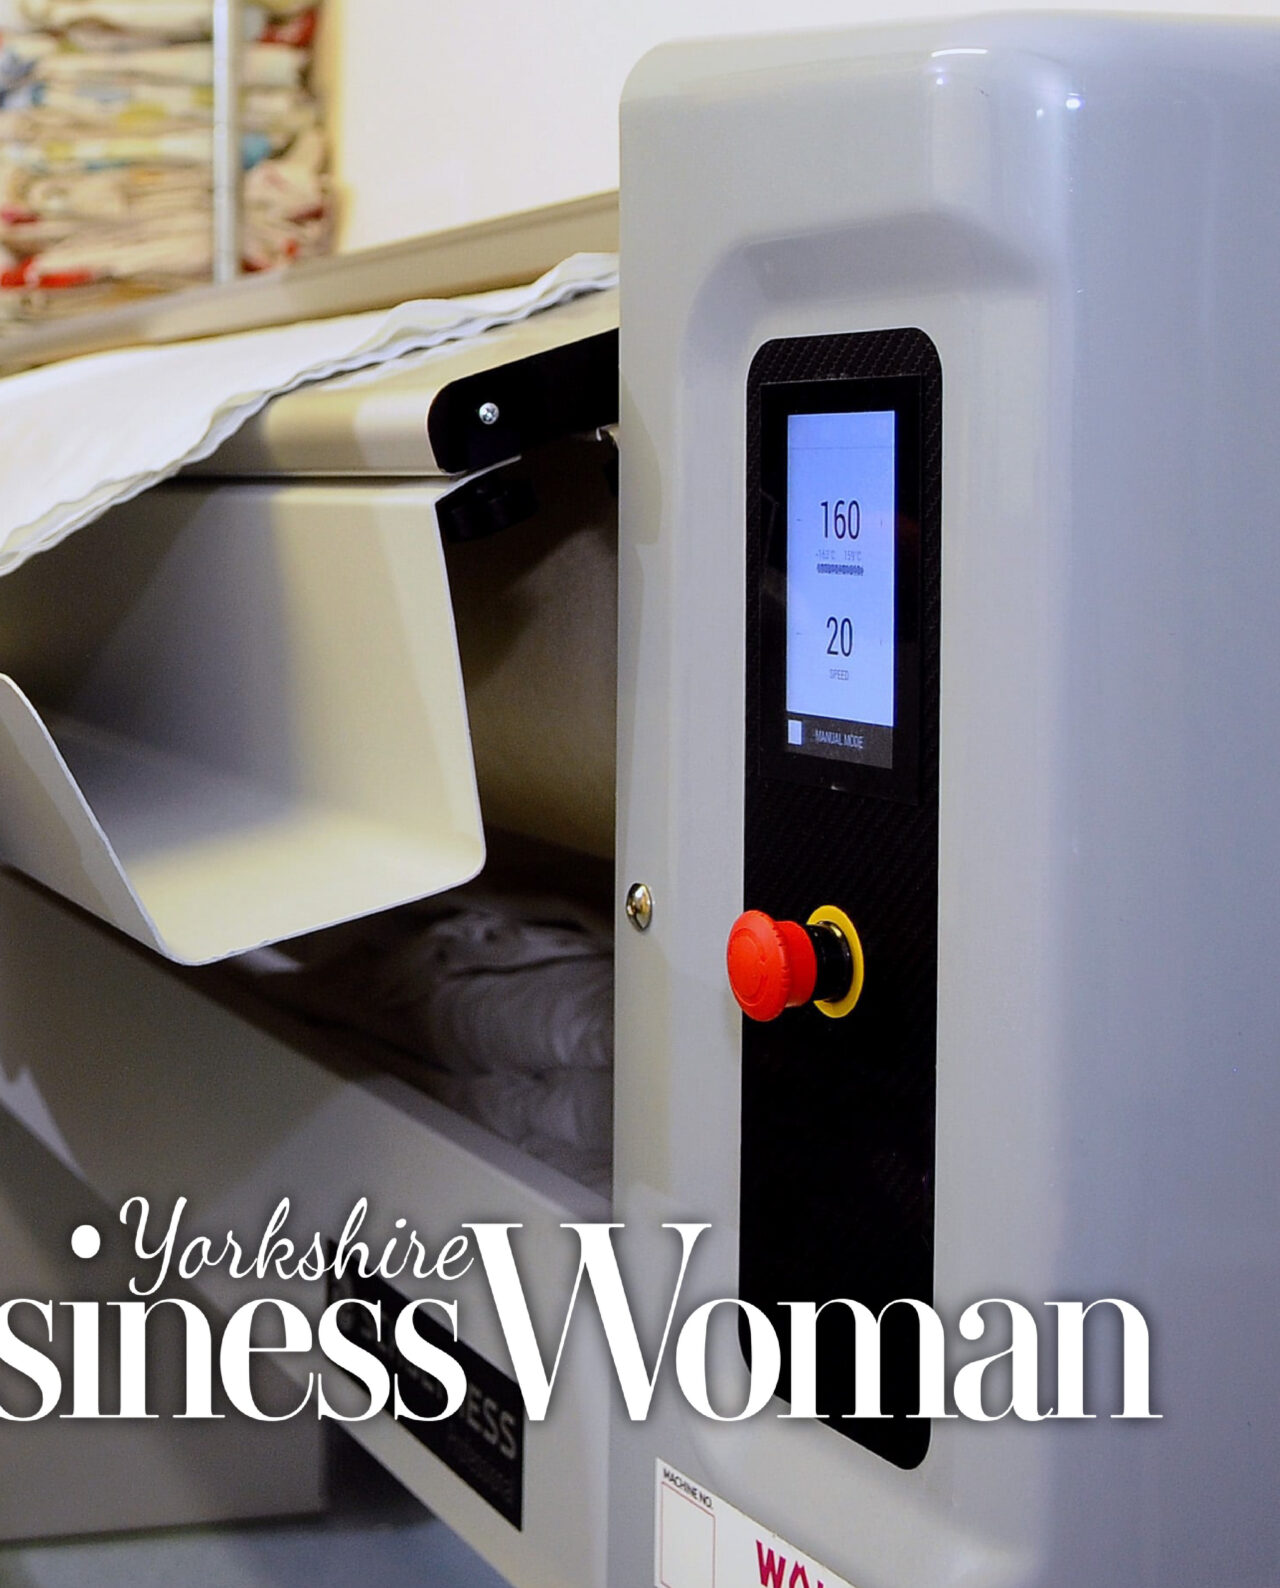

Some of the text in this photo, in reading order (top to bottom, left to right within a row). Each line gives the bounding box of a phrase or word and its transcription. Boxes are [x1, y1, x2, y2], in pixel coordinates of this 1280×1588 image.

[820, 500, 860, 540] 160
[826, 616, 853, 657] 20
[829, 669, 849, 681] SPEED
[663, 1468, 697, 1500] MACHINE
[755, 1539, 825, 1588] WO
